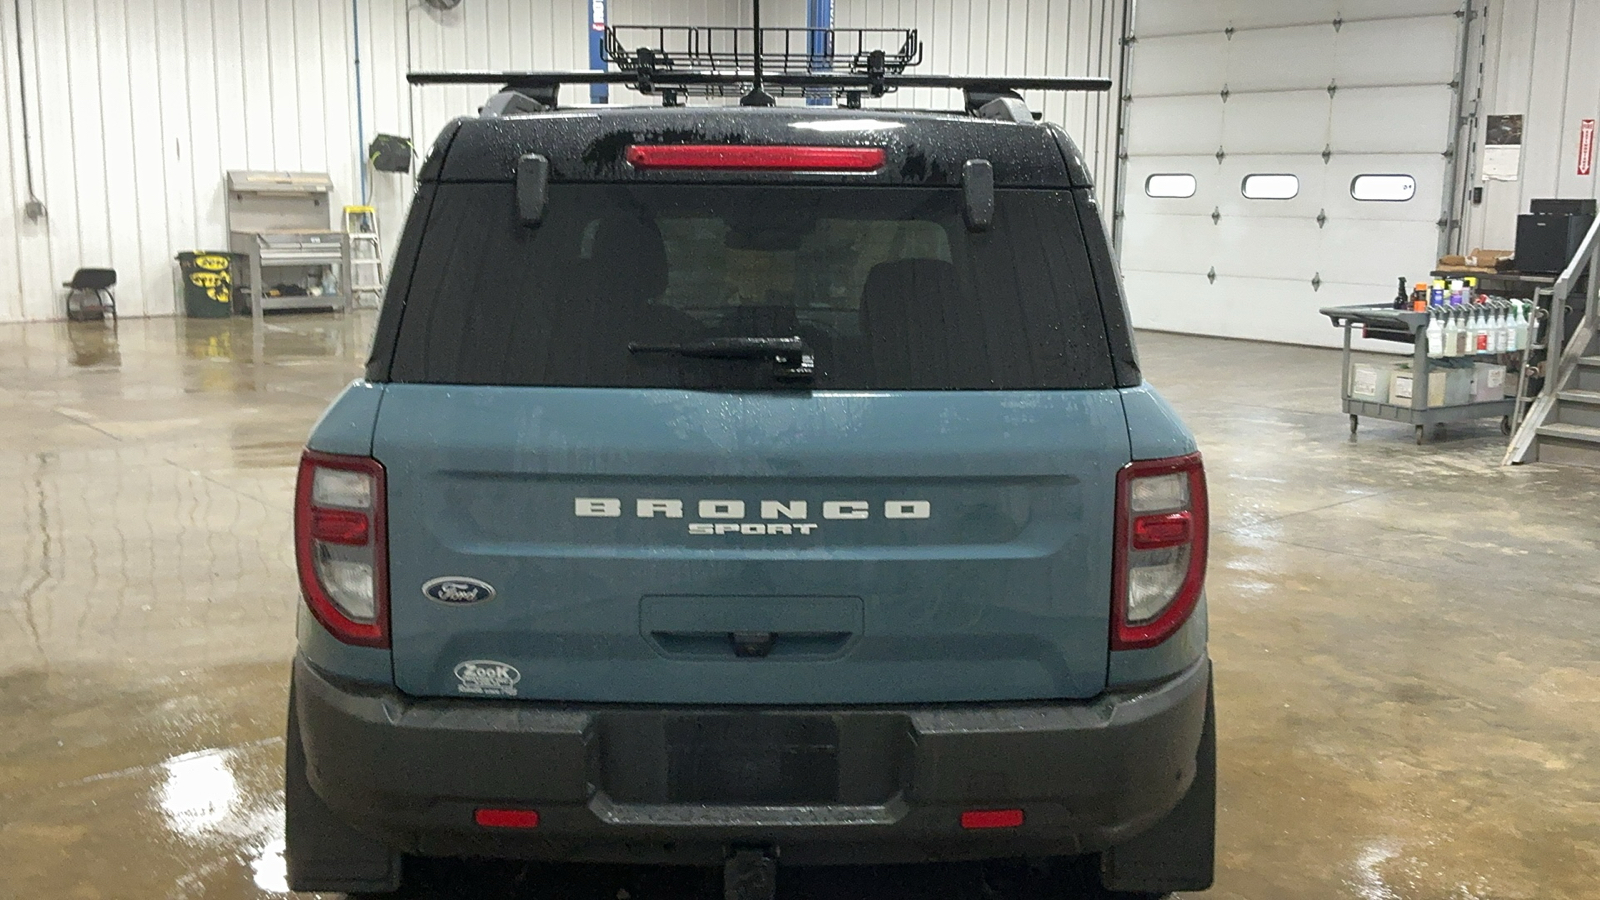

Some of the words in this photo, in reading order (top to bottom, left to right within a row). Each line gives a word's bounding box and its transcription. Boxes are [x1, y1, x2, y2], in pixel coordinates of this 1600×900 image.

[575, 498, 931, 519] BRONCO
[688, 523, 818, 535] SPORT
[438, 582, 478, 600] Ford
